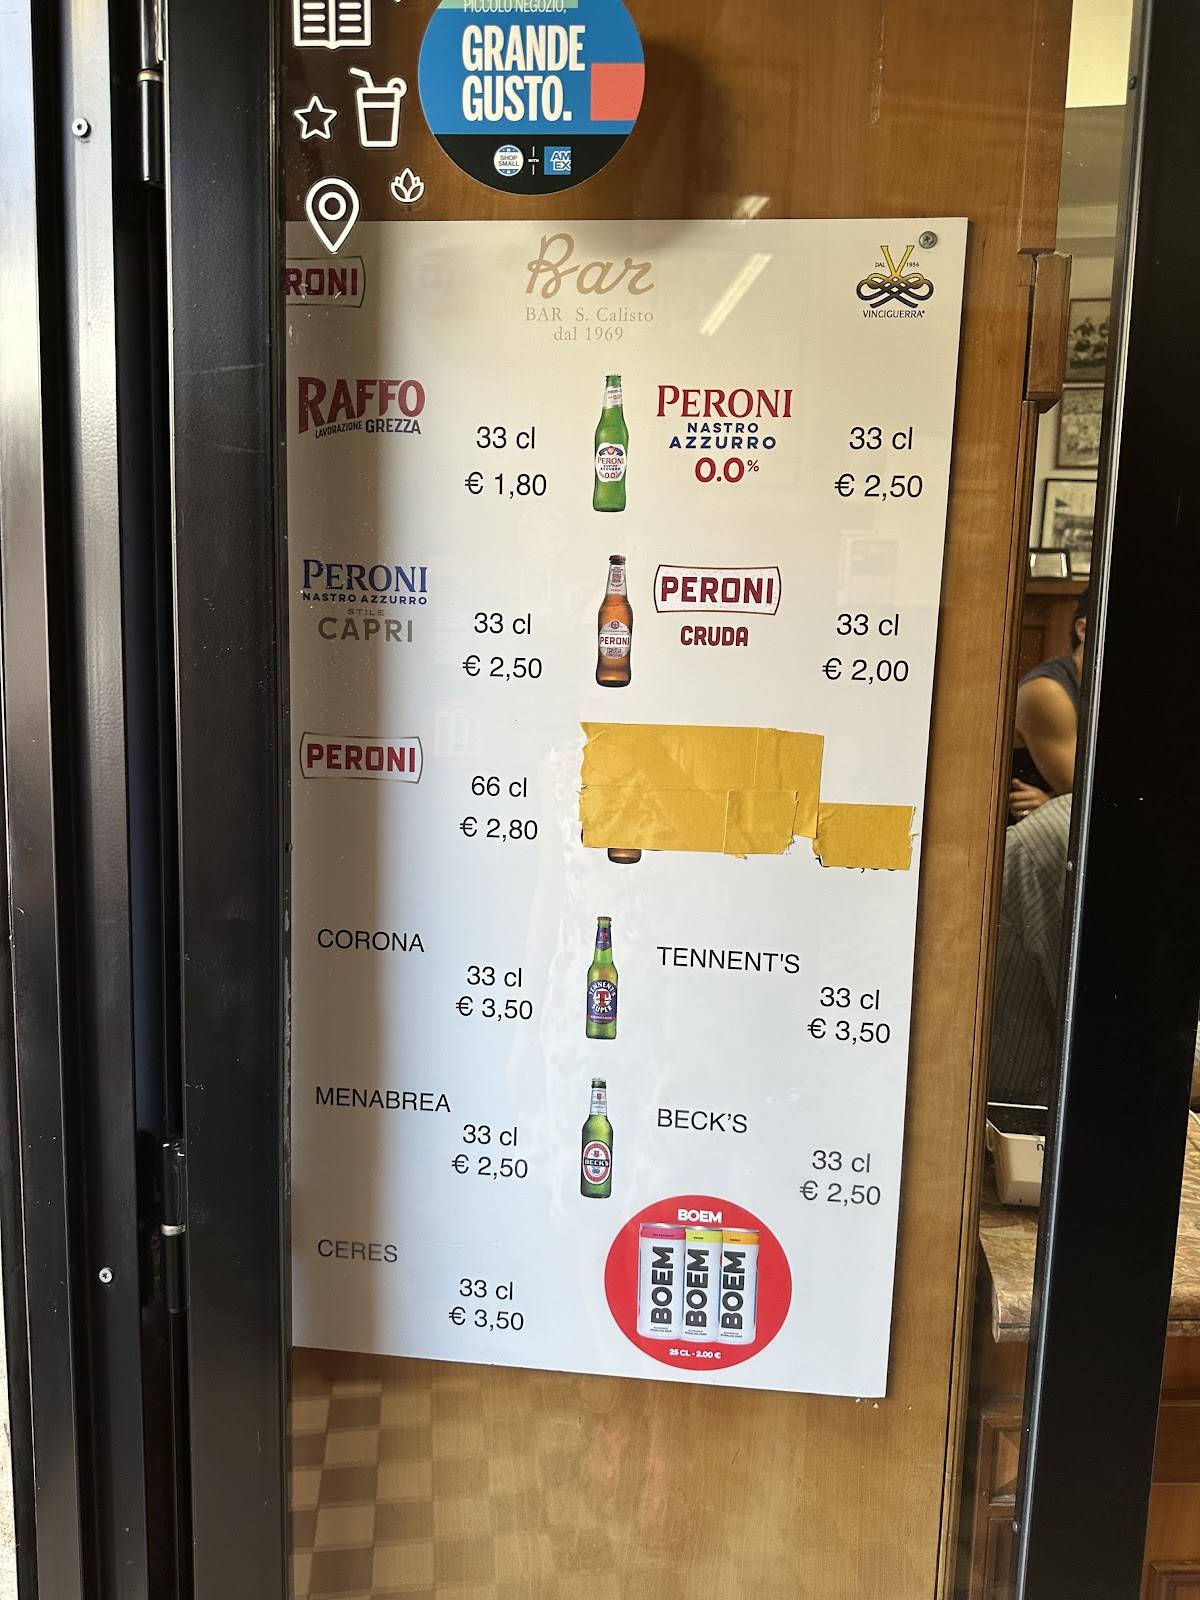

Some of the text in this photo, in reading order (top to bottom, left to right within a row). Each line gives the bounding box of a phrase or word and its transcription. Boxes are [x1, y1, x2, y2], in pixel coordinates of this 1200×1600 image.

[464, 0, 566, 13] PICCOLO NEGOZIO,
[462, 25, 585, 71] GRANDE
[462, 76, 572, 121] GUSTO.
[525, 232, 655, 299] Bar
[284, 268, 358, 296] RONI
[525, 306, 655, 323] BAR S. Calisto
[553, 325, 624, 342] dal 1969
[298, 376, 426, 434] RAFFO
[656, 385, 793, 418] PERONI
[315, 418, 421, 439] LAVORAZIONE GREZZA
[476, 426, 536, 449] 33 cl
[687, 422, 759, 434] NASTRO
[849, 426, 913, 450] 33 cl
[669, 436, 777, 450] AZZURRO
[598, 456, 624, 465] PERONI
[695, 457, 760, 483] 0.0%
[464, 472, 547, 499] € 1,80
[834, 473, 923, 501] € 2,50
[303, 559, 428, 593] PERONI
[303, 593, 427, 605] NASTRO AZZURRO
[660, 576, 774, 604] PERONI
[347, 608, 385, 616] STILE
[473, 613, 532, 634] 33 cl
[318, 616, 413, 642] CAPRI
[681, 626, 749, 647] CRUDA
[836, 614, 900, 636] 33 cl
[600, 636, 630, 645] PERONI
[462, 656, 543, 682] € 2,50
[822, 658, 909, 684] € 2,00
[306, 743, 416, 773] PERONI
[471, 776, 528, 798] 66 cl
[459, 816, 538, 842] € 2,80
[317, 929, 425, 952] CORONA
[657, 946, 800, 974] TENNENT'S
[466, 966, 522, 988] 33 cl
[456, 996, 533, 1021] € 3,50
[820, 986, 880, 1010] 33 cl
[808, 1018, 891, 1045] € 3,50
[316, 1087, 451, 1112] MENABREA
[657, 1109, 748, 1133] BECK’S
[463, 1125, 518, 1146] 33 cl
[452, 1154, 528, 1179] € 2,50
[812, 1150, 871, 1173] 33 cl
[800, 1180, 881, 1207] € 2,50
[677, 1209, 723, 1223] BOEM
[317, 1239, 398, 1263] CERES
[459, 1279, 514, 1300] 33 cl
[651, 1246, 674, 1324] BOEM
[685, 1248, 709, 1327] BOEM
[721, 1251, 746, 1329] BOEM
[449, 1307, 524, 1331] € 3,50
